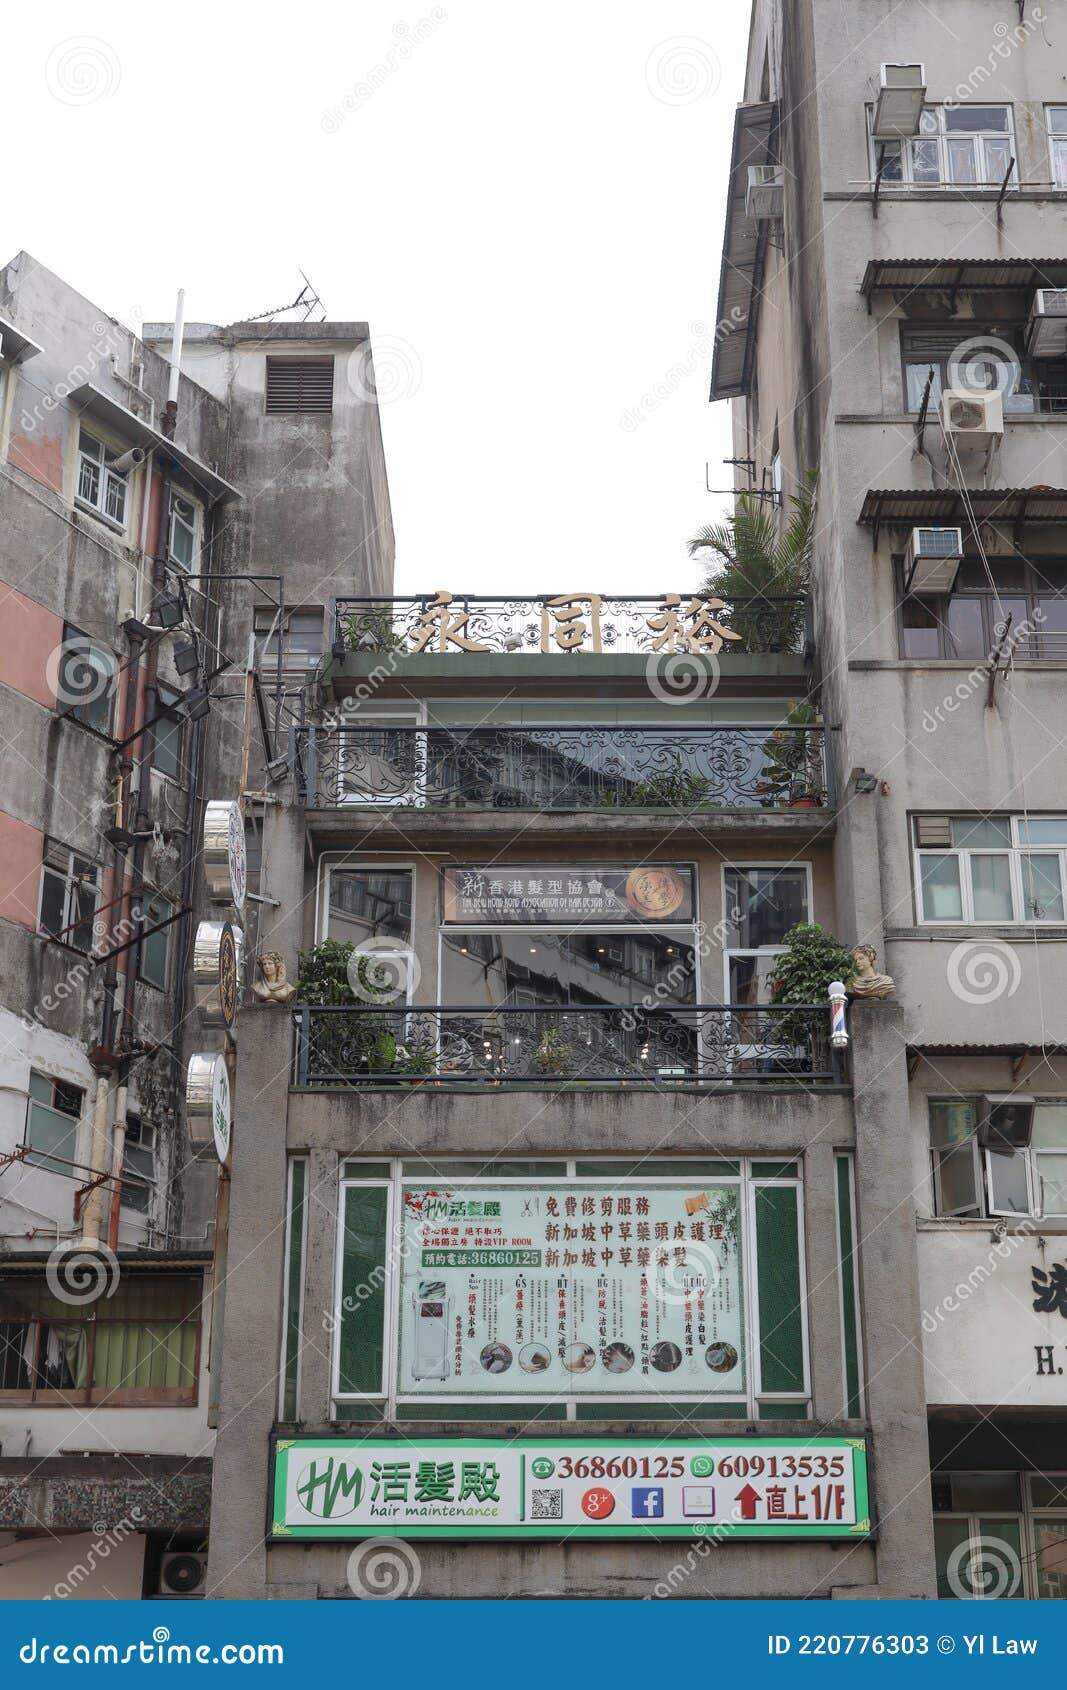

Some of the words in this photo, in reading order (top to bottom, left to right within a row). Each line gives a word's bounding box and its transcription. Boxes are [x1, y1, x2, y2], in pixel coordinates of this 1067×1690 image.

[462, 872, 603, 898] 新香港髮型協會
[423, 1199, 448, 1220] HM
[450, 1200, 501, 1217] 活髮殿
[545, 1196, 651, 1217] 免費修剪服務
[511, 1238, 532, 1246] ROOM
[545, 1221, 725, 1242] 新加坡中草藥頭皮護理
[424, 1251, 539, 1266] 預約電話:36860125
[545, 1247, 688, 1268] 新加坡中草藥染髮
[515, 1278, 527, 1289] GS
[557, 1455, 686, 1479] 36860125
[717, 1455, 846, 1479] 60913535
[297, 1457, 365, 1518] HM
[370, 1461, 501, 1503] 活髮殿
[370, 1504, 400, 1517] hair
[405, 1504, 499, 1517] maintenance
[766, 1483, 846, 1520] 直上1/F
